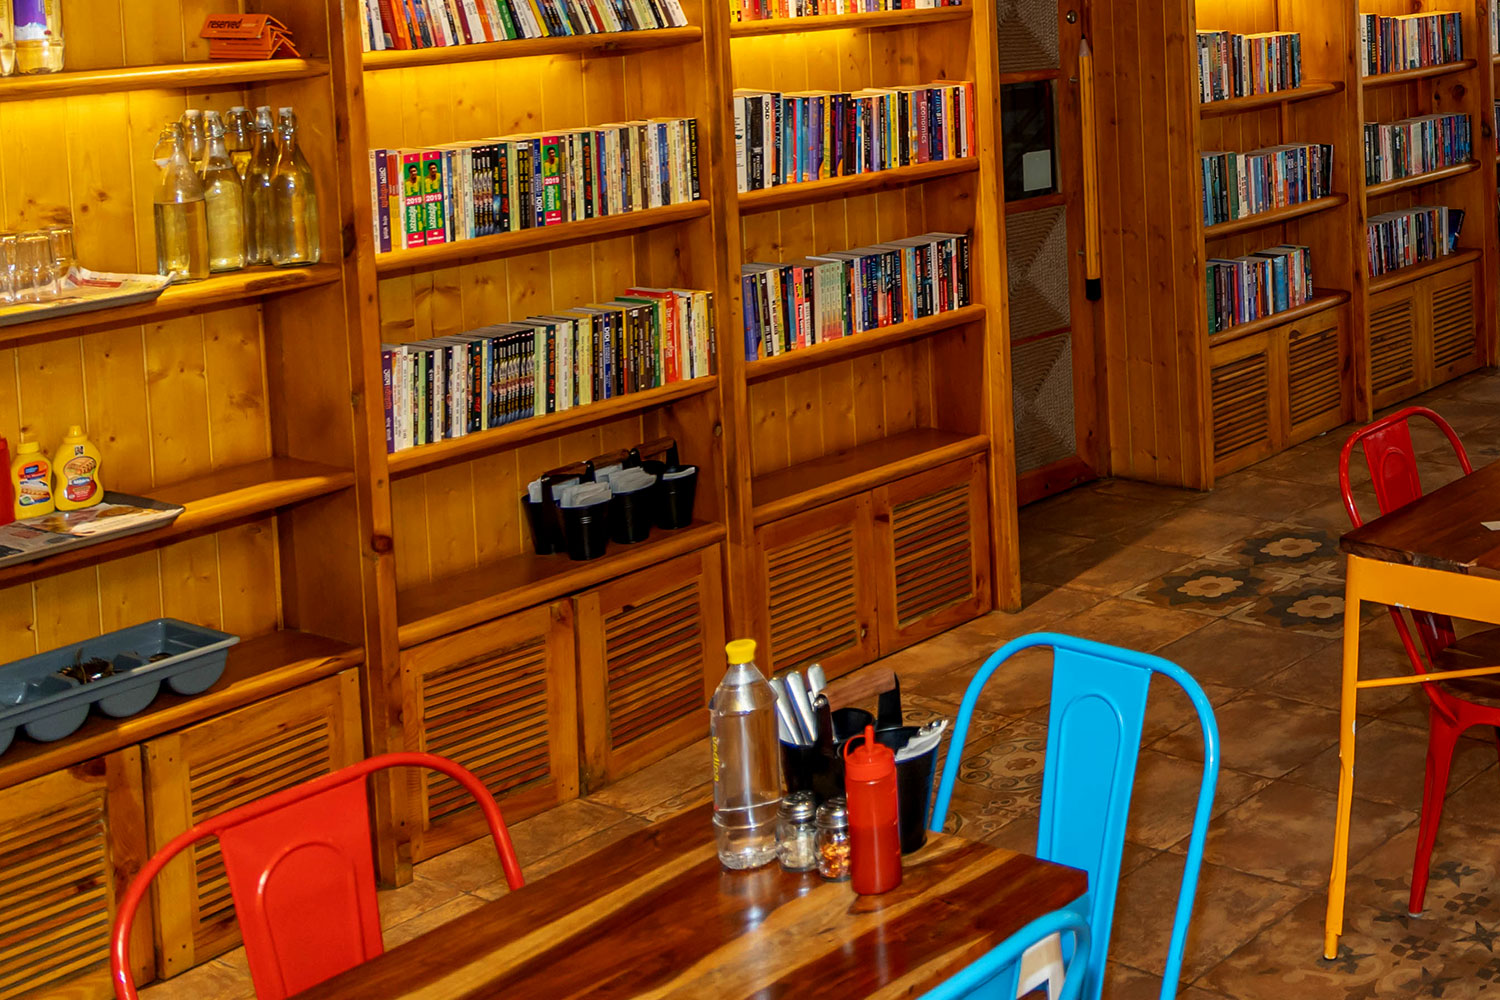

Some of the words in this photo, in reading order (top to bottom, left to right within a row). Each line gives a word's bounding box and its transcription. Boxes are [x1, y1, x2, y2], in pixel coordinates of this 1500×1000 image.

[207, 18, 243, 29] reserved
[544, 176, 560, 185] 2019
[405, 196, 422, 206] 2019
[425, 193, 442, 203] 2019
